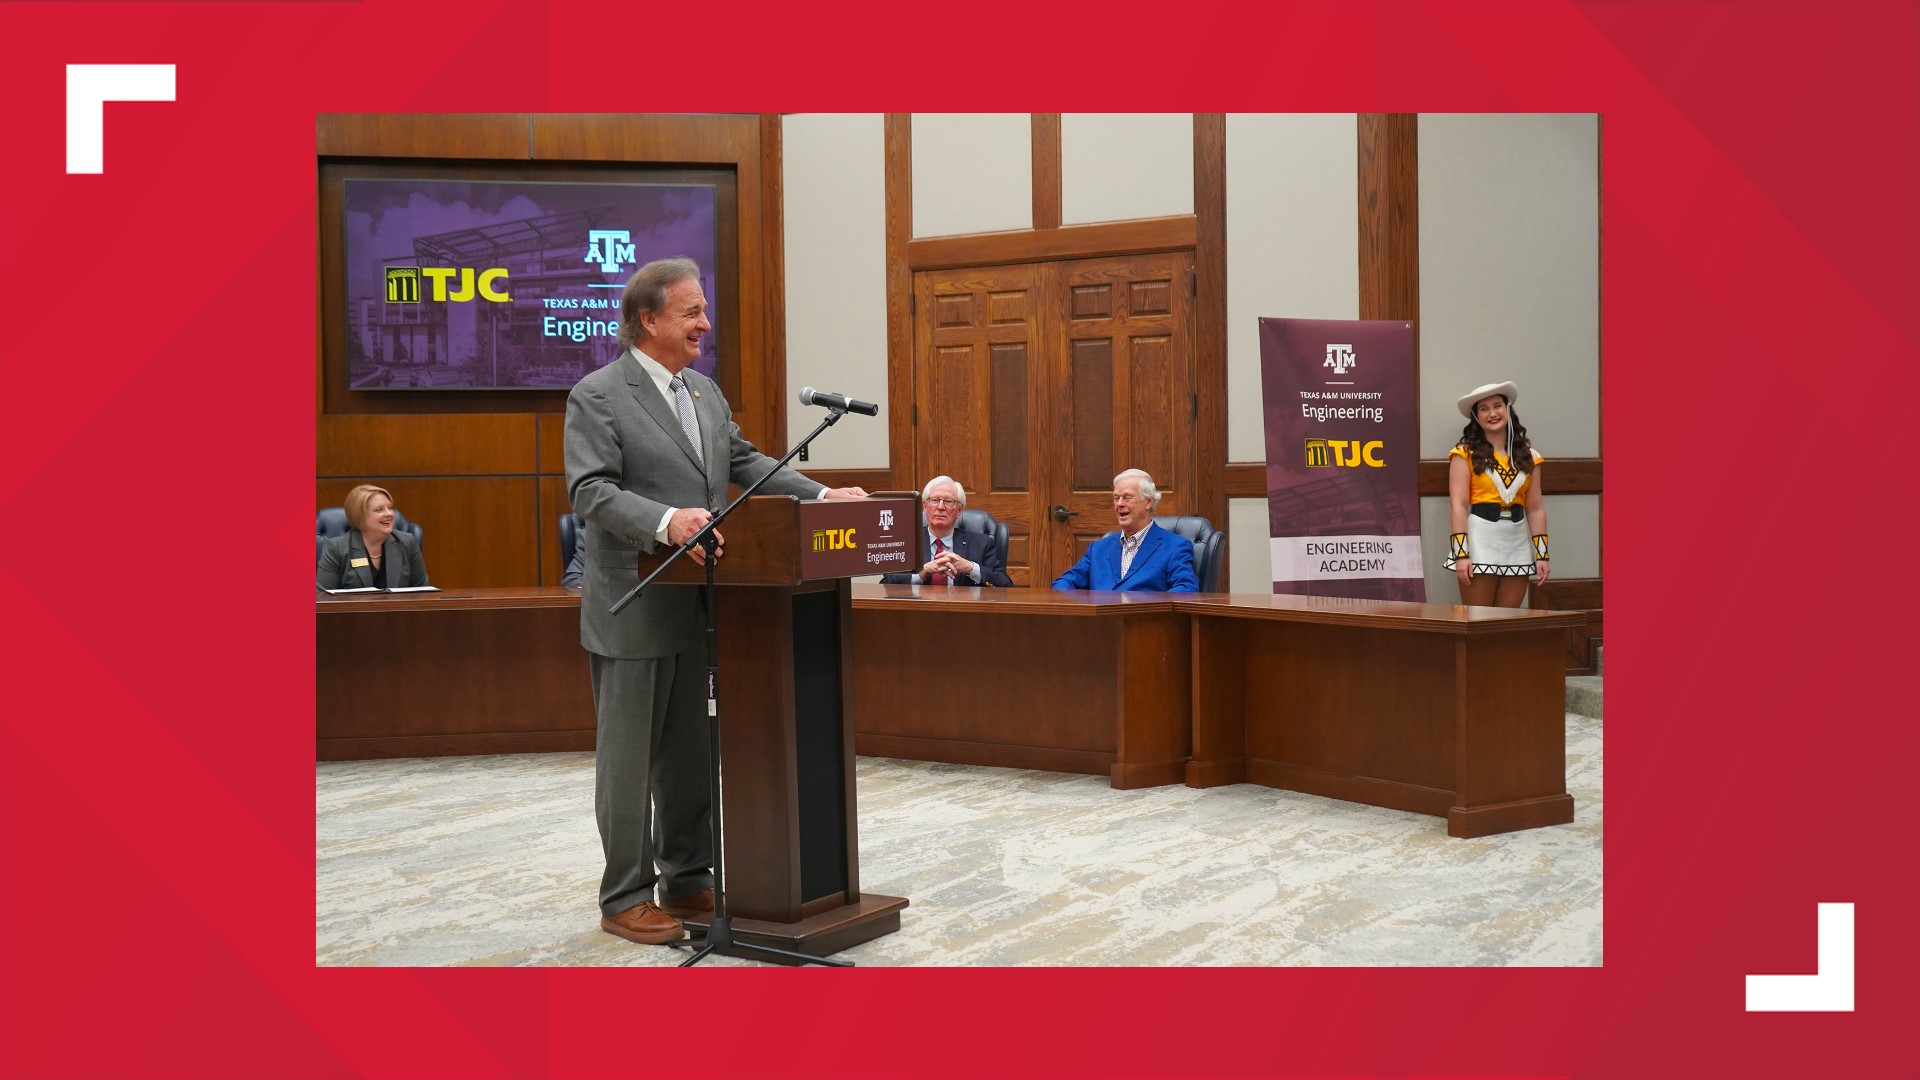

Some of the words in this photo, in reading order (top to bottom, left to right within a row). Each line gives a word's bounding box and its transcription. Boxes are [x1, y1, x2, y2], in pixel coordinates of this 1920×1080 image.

[422, 267, 511, 303] TJC
[542, 298, 579, 309] TEXAS
[581, 298, 608, 309] A&M
[1300, 391, 1320, 399] TEXAS
[1321, 391, 1339, 400] A&M
[1340, 391, 1382, 400] UNIVERSITY
[1302, 403, 1384, 423] Engineering
[1328, 439, 1385, 468] TJC
[825, 528, 857, 550] TJC
[1306, 541, 1393, 556] ENGINEERING
[867, 550, 906, 565] Engineering
[1319, 558, 1386, 573] ACADEMY
